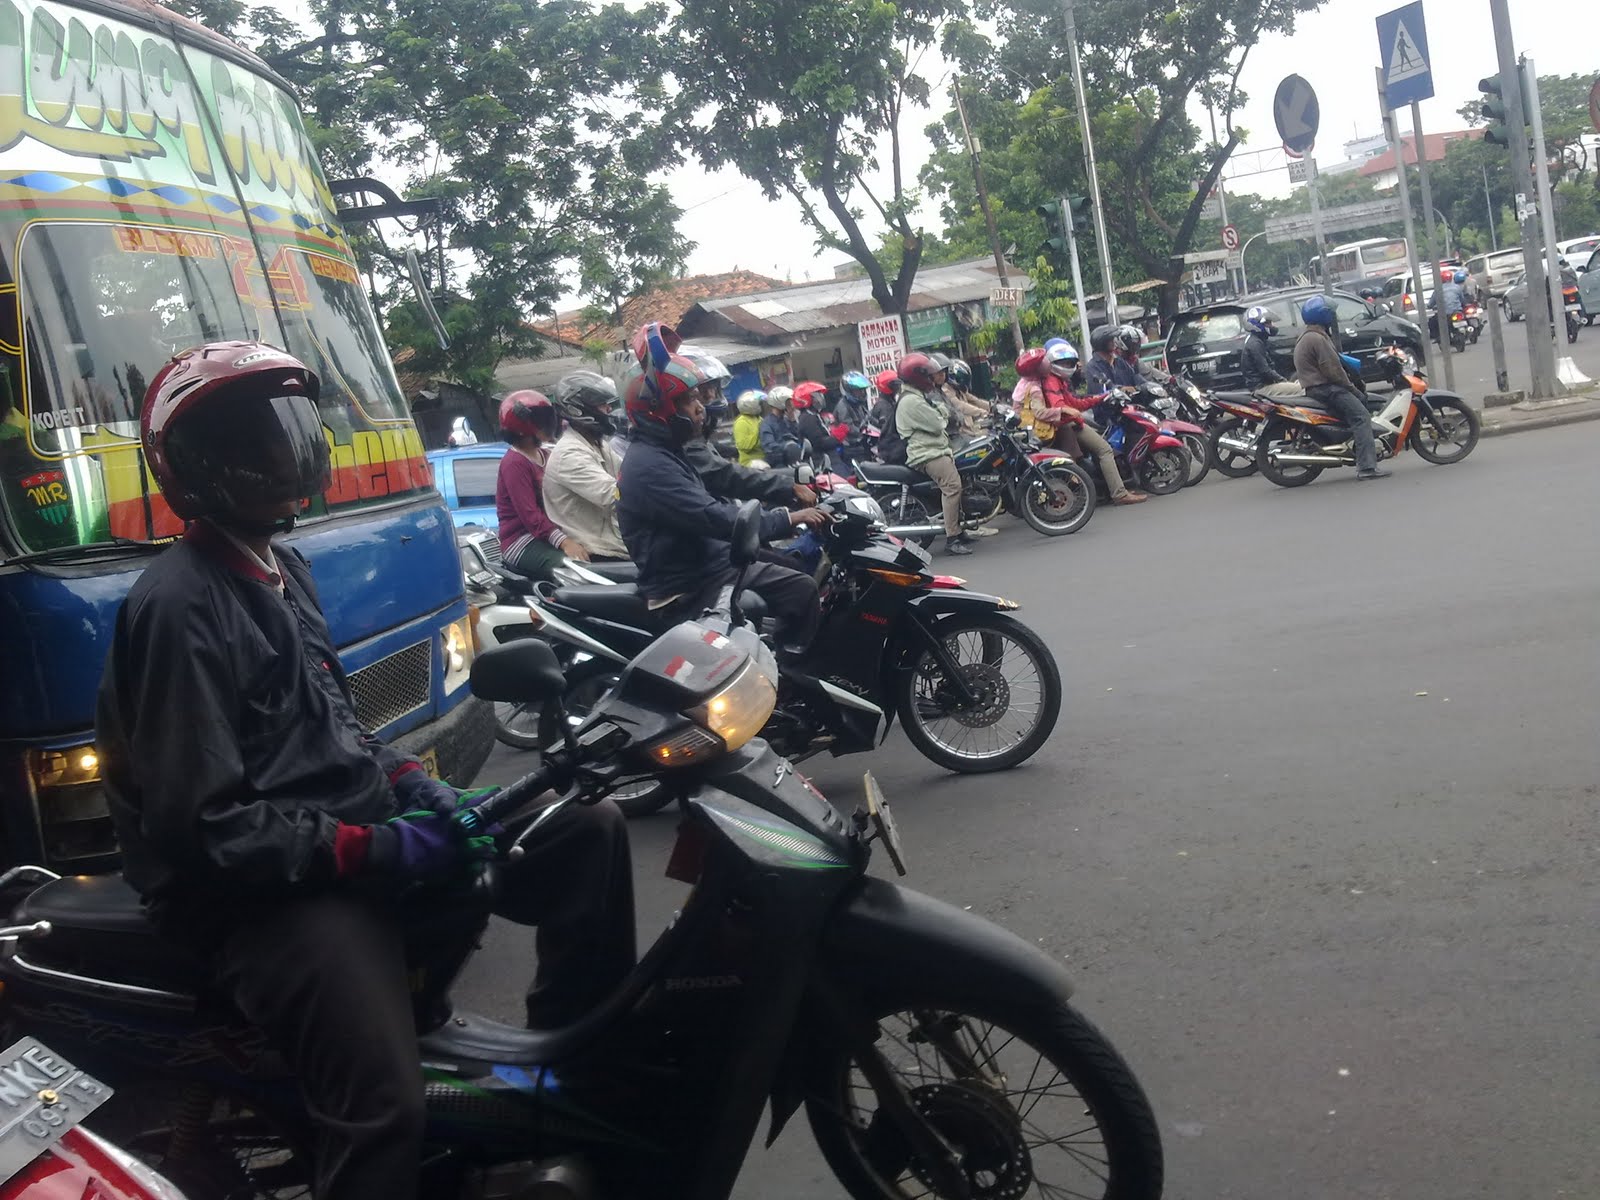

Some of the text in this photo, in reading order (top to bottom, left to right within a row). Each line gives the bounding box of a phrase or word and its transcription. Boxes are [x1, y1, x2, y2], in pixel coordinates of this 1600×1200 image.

[860, 319, 899, 339] RAMAYANA
[866, 335, 897, 350] MOTOR
[865, 351, 892, 366] HONDA
[33, 407, 86, 431] KOPETT
[27, 482, 68, 507] MR
[663, 975, 744, 993] HONDA
